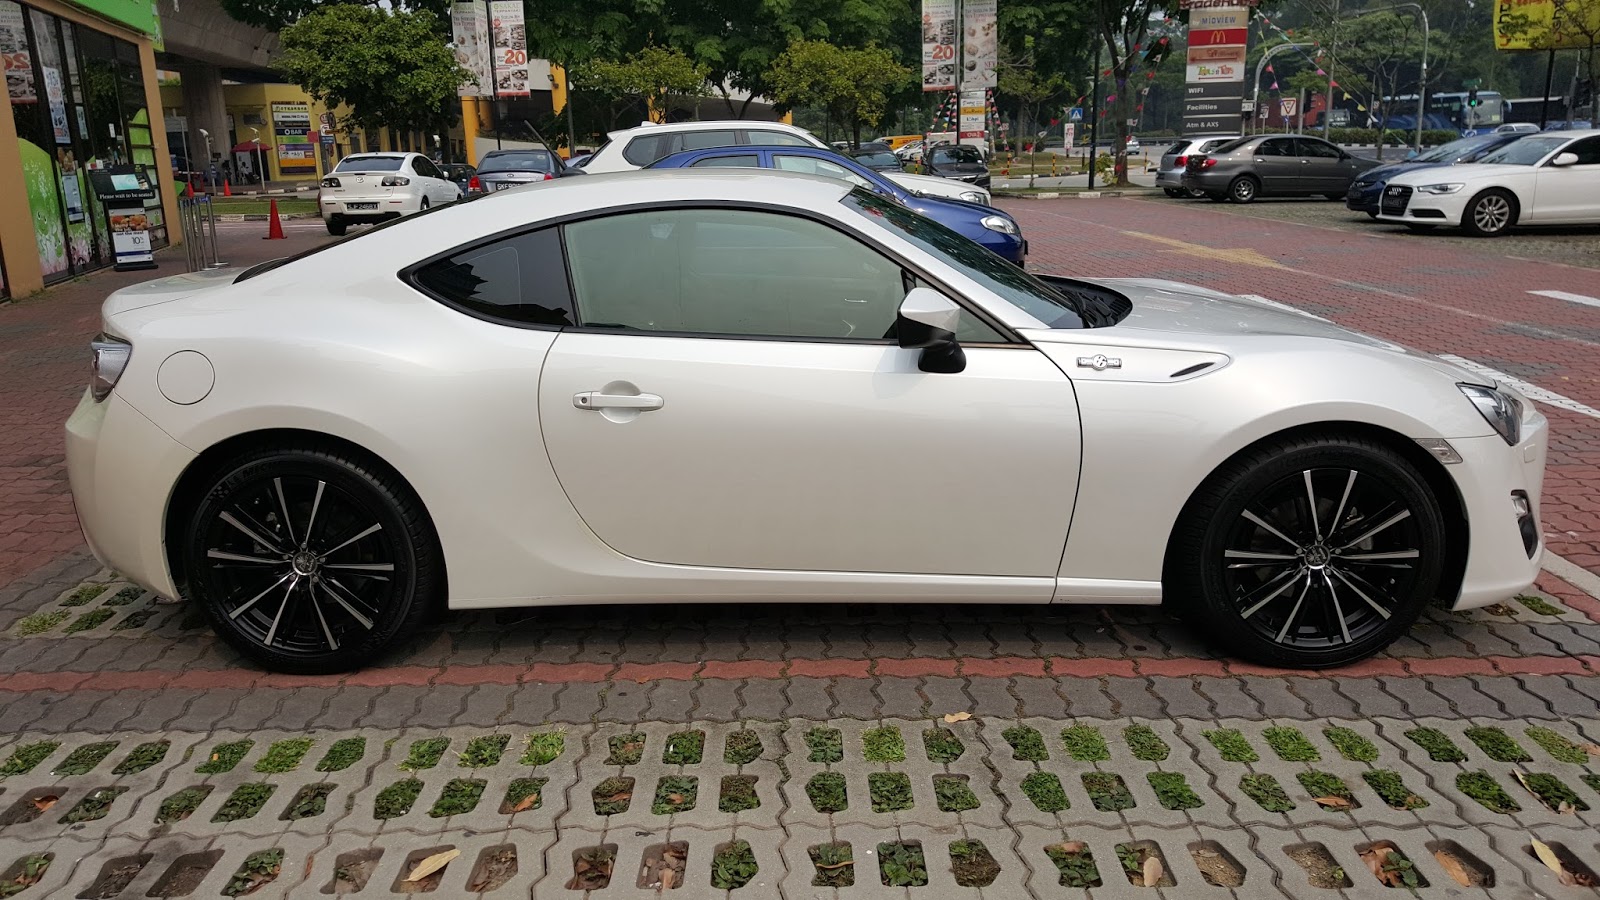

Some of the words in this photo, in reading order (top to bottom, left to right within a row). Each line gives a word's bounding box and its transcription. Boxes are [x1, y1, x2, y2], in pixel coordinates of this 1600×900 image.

[1202, 15, 1236, 25] MIDVIEW
[505, 50, 526, 65] 20
[932, 45, 954, 60] 20
[1186, 103, 1218, 111] Facilities
